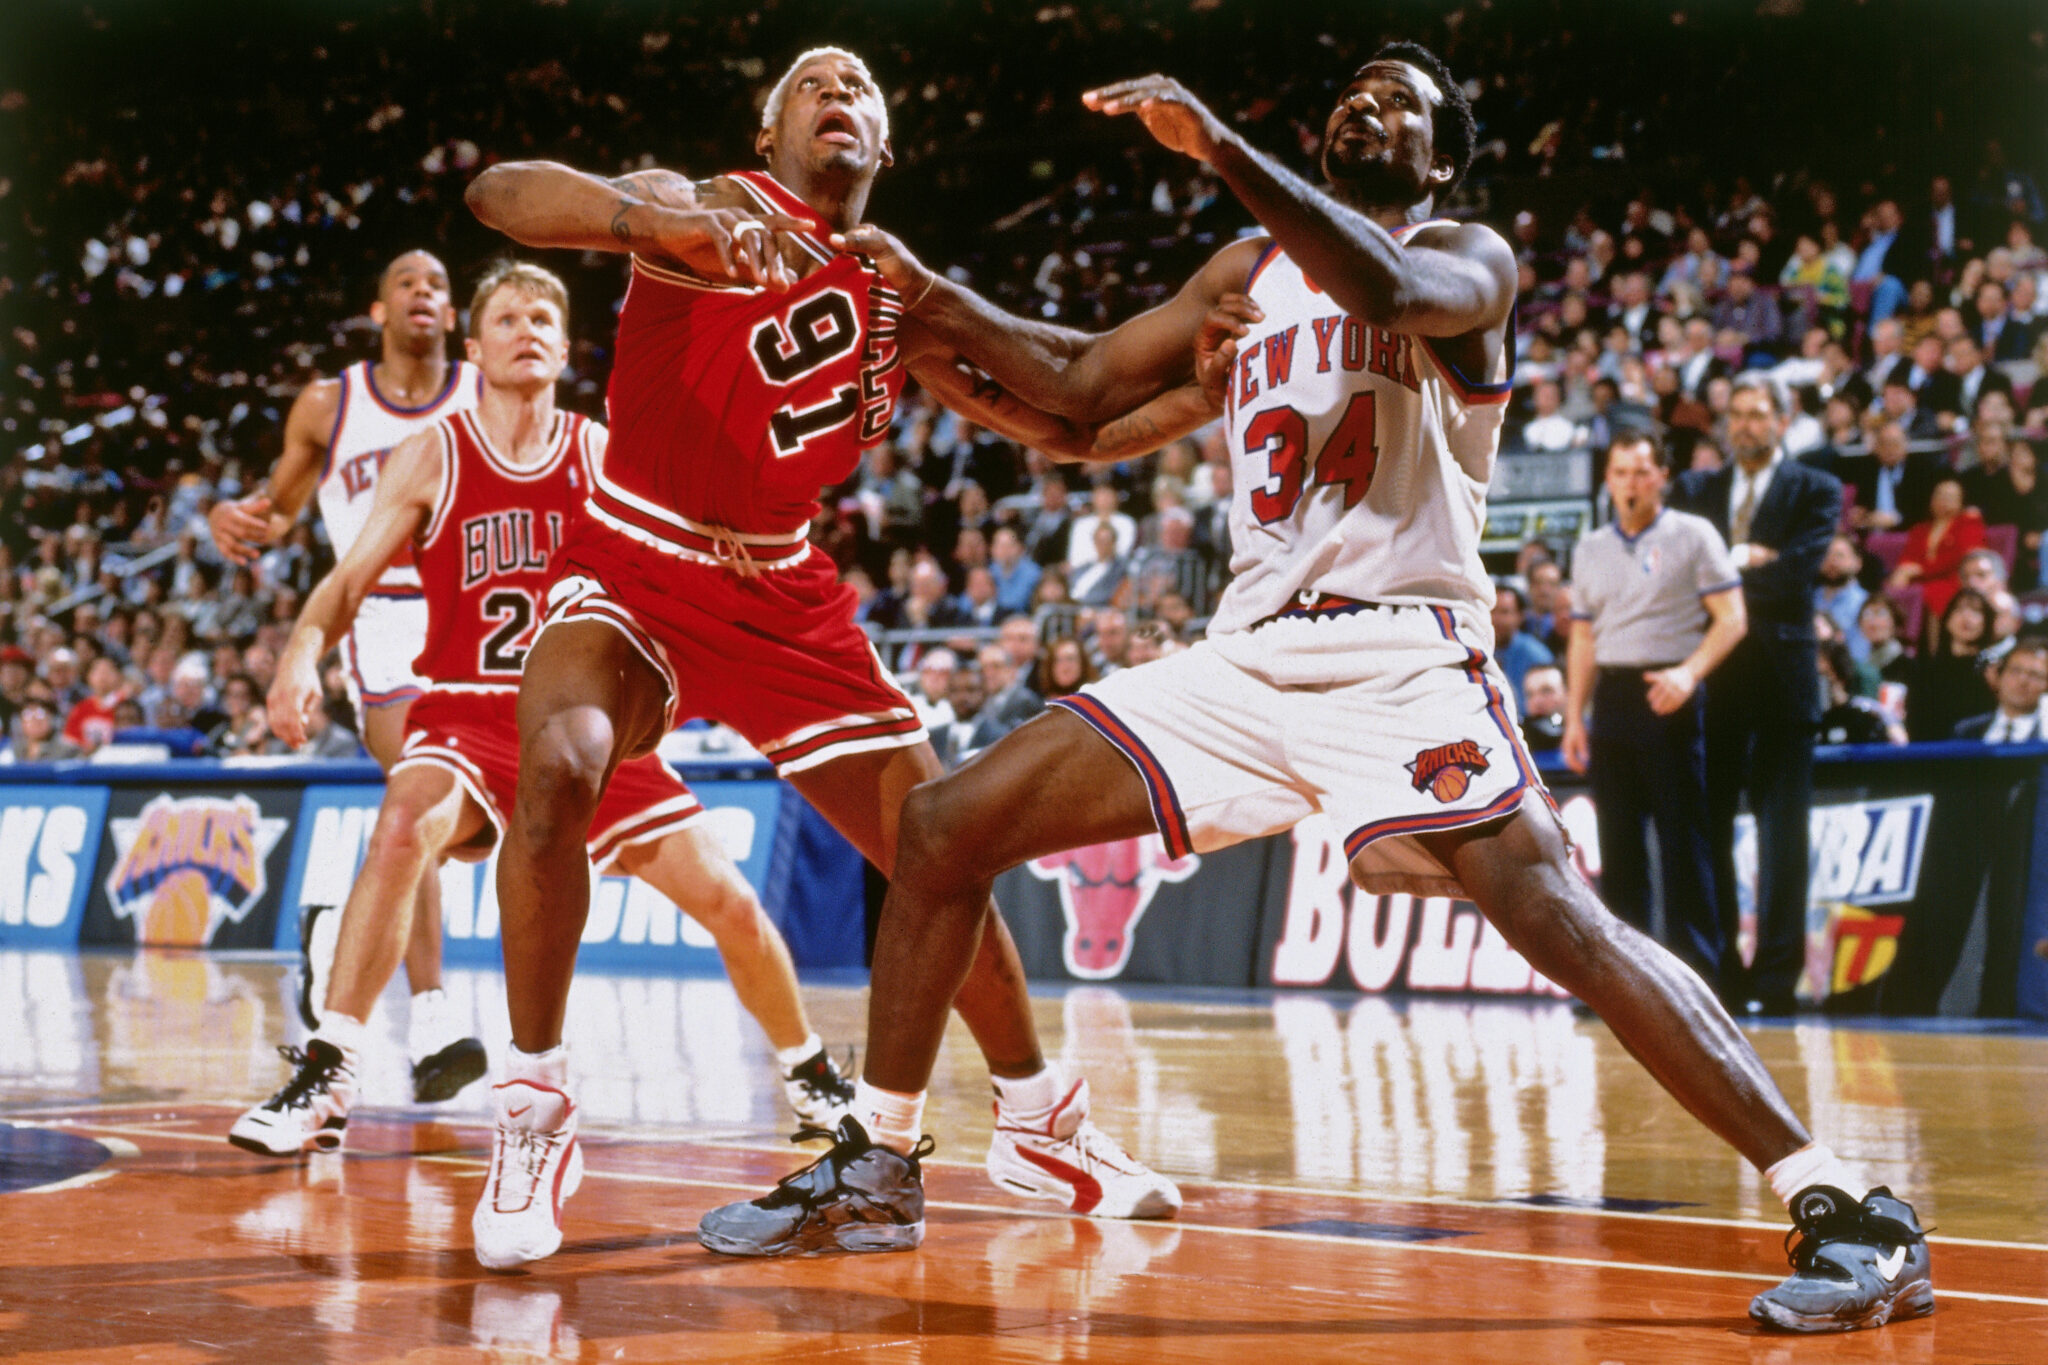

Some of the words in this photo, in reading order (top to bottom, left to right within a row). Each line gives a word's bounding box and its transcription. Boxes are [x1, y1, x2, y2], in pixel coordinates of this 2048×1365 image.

[748, 287, 862, 459] 91
[1243, 389, 1380, 527] 34
[478, 587, 543, 677] 2
[1412, 740, 1490, 793] KNICKS
